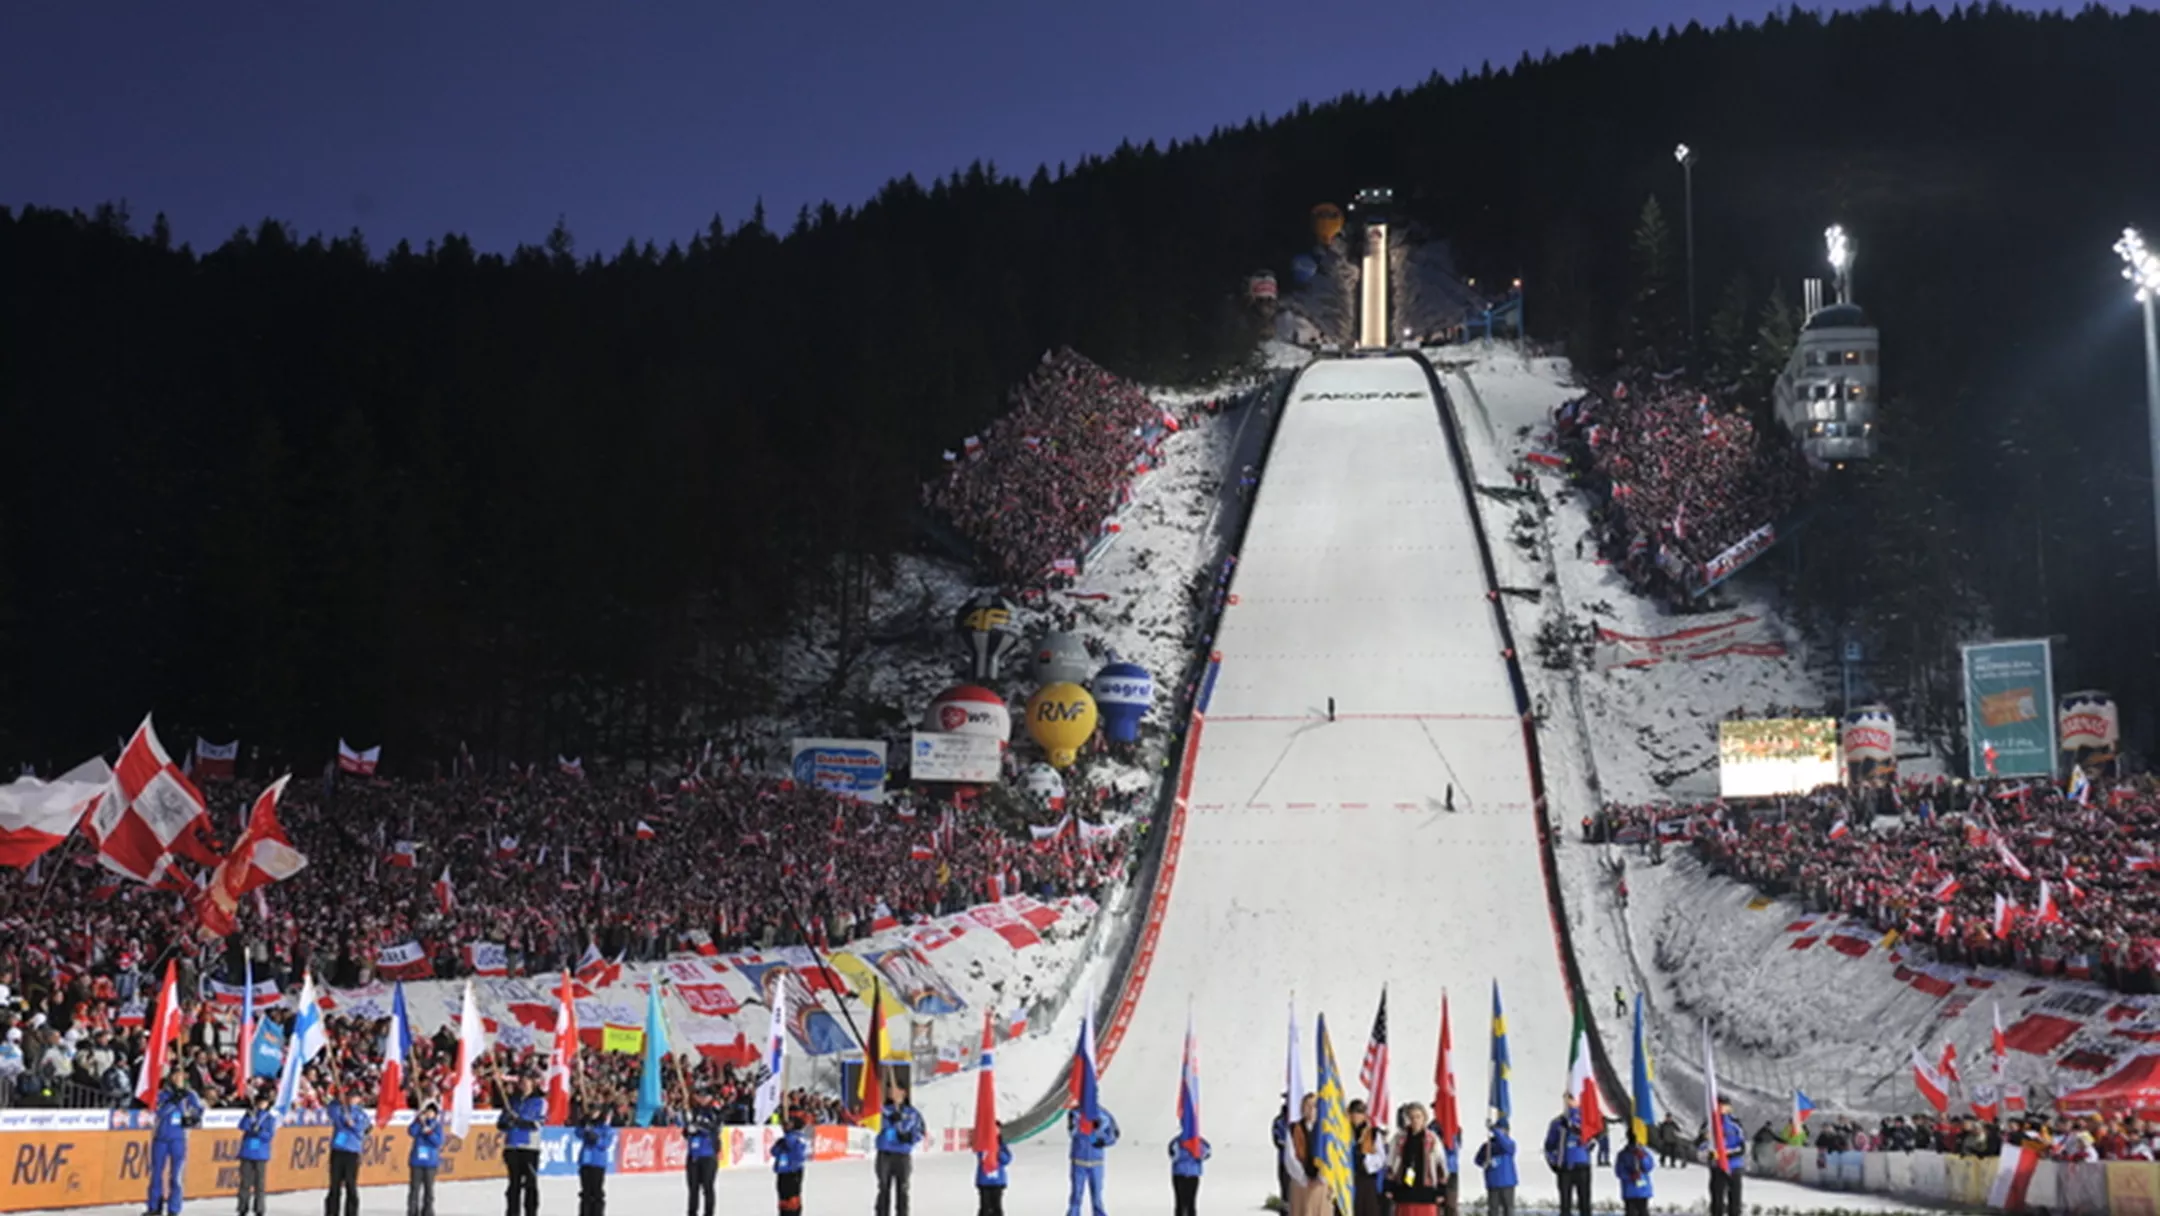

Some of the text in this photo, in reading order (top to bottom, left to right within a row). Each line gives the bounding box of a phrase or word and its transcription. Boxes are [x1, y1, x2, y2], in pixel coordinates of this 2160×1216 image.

[1300, 390, 1424, 402] ZAKOPANE
[1037, 701, 1085, 722] RMF
[12, 1143, 75, 1185] RMF
